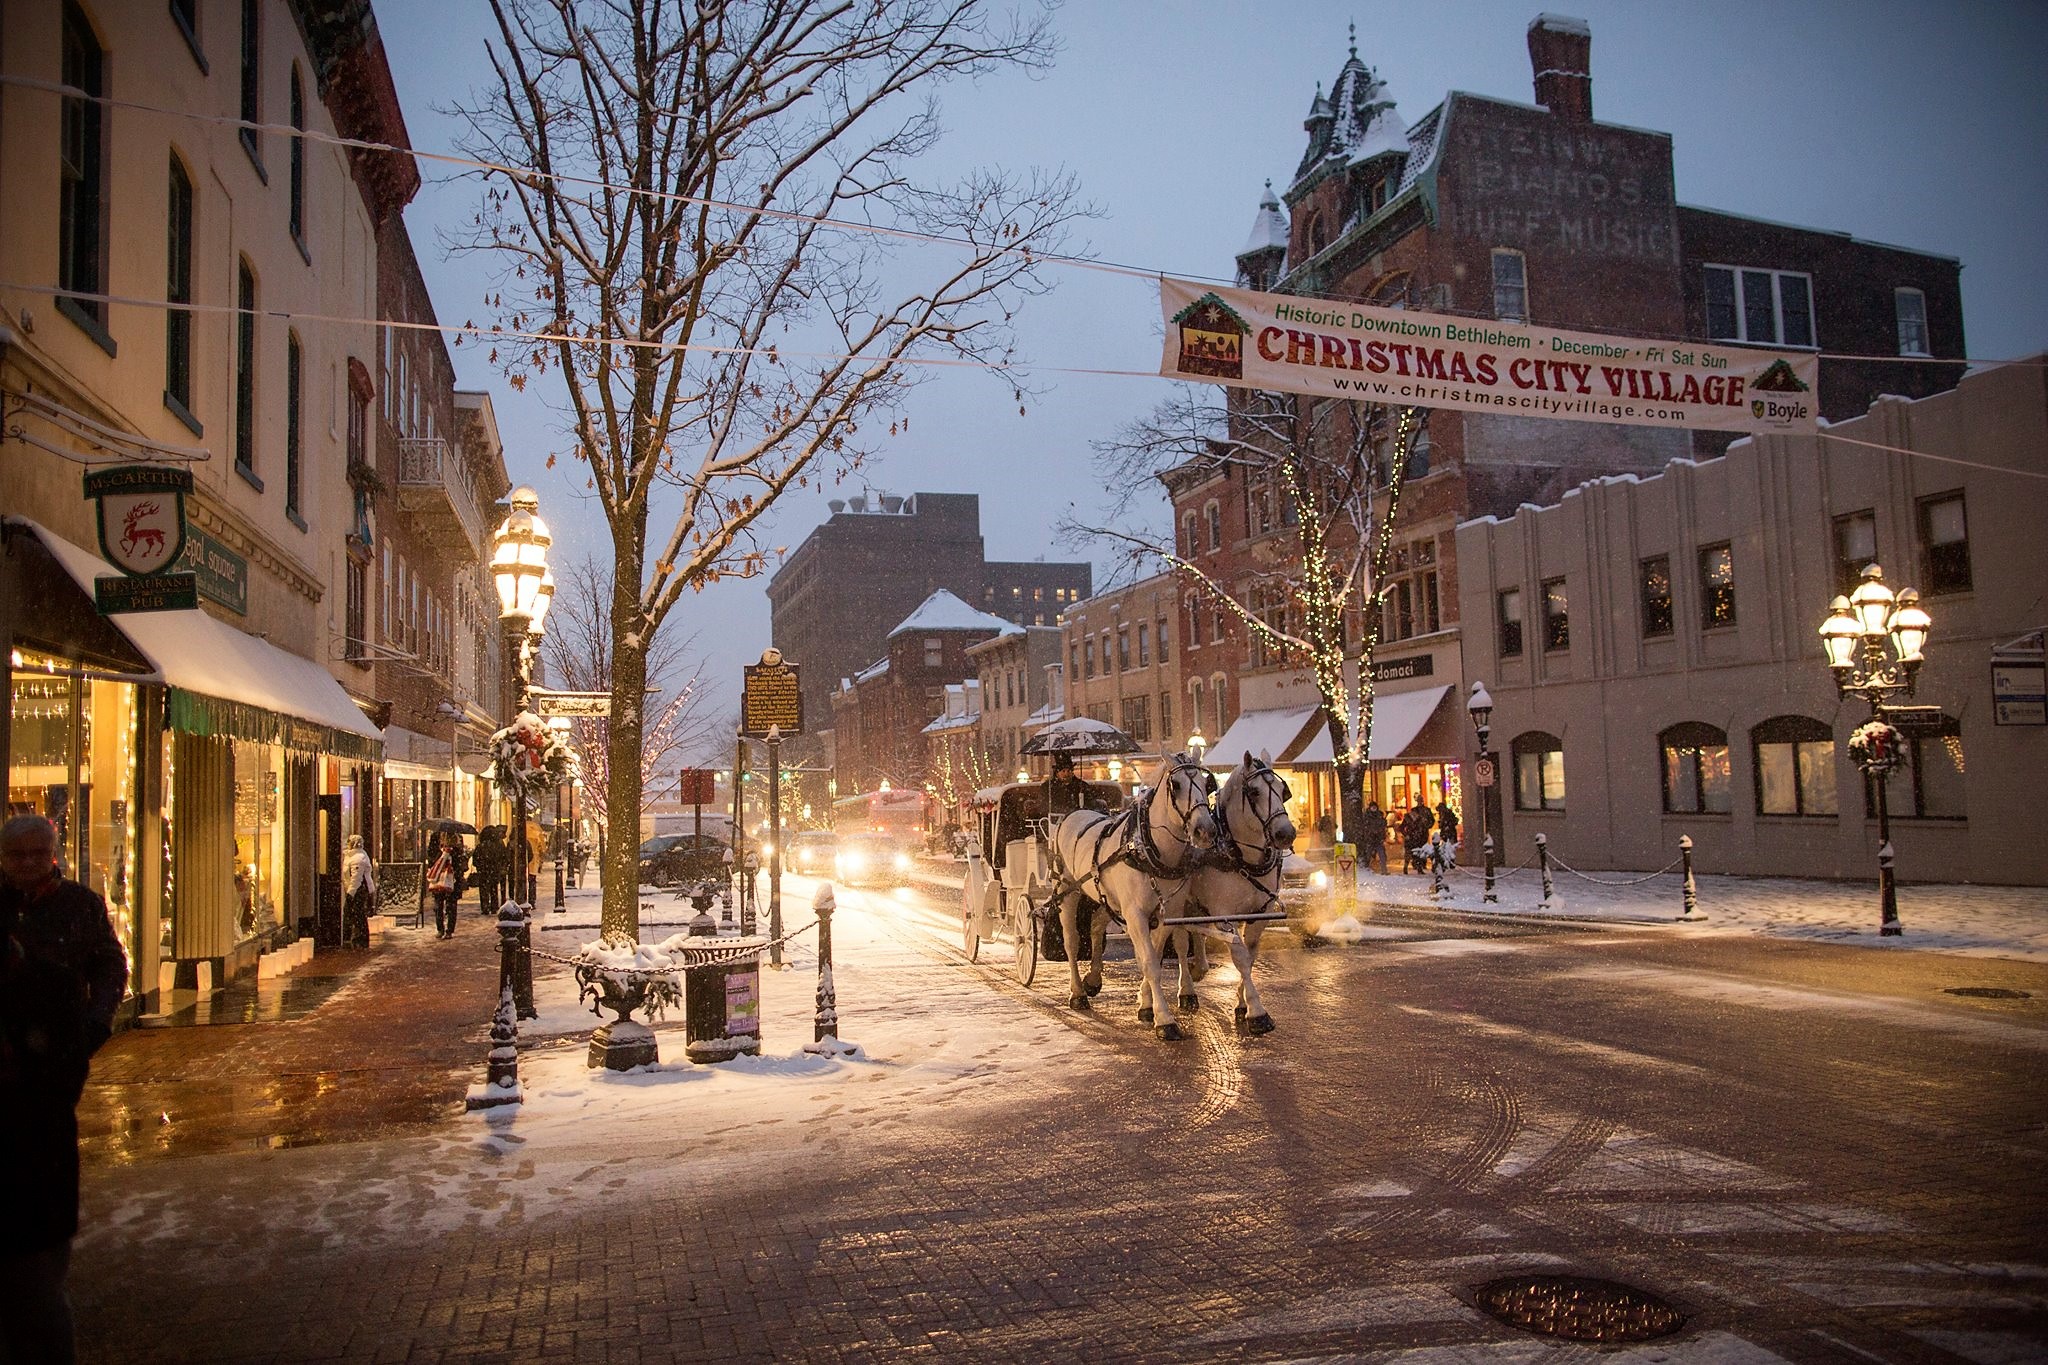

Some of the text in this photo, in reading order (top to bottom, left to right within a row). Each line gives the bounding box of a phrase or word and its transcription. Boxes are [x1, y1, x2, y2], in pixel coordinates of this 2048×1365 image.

[1558, 216, 1666, 259] MUSIC
[1275, 303, 1728, 370] Historic Downtown Bethlehem December Fri Sat Sun
[1257, 325, 1746, 408] CHRISTMAS CITY VILLAGE
[1333, 378, 1686, 421] www.christmascityvillage.com
[1767, 401, 1808, 423] Boyle
[208, 551, 235, 582] square
[131, 597, 164, 608] PUB
[1377, 661, 1414, 680] domaci
